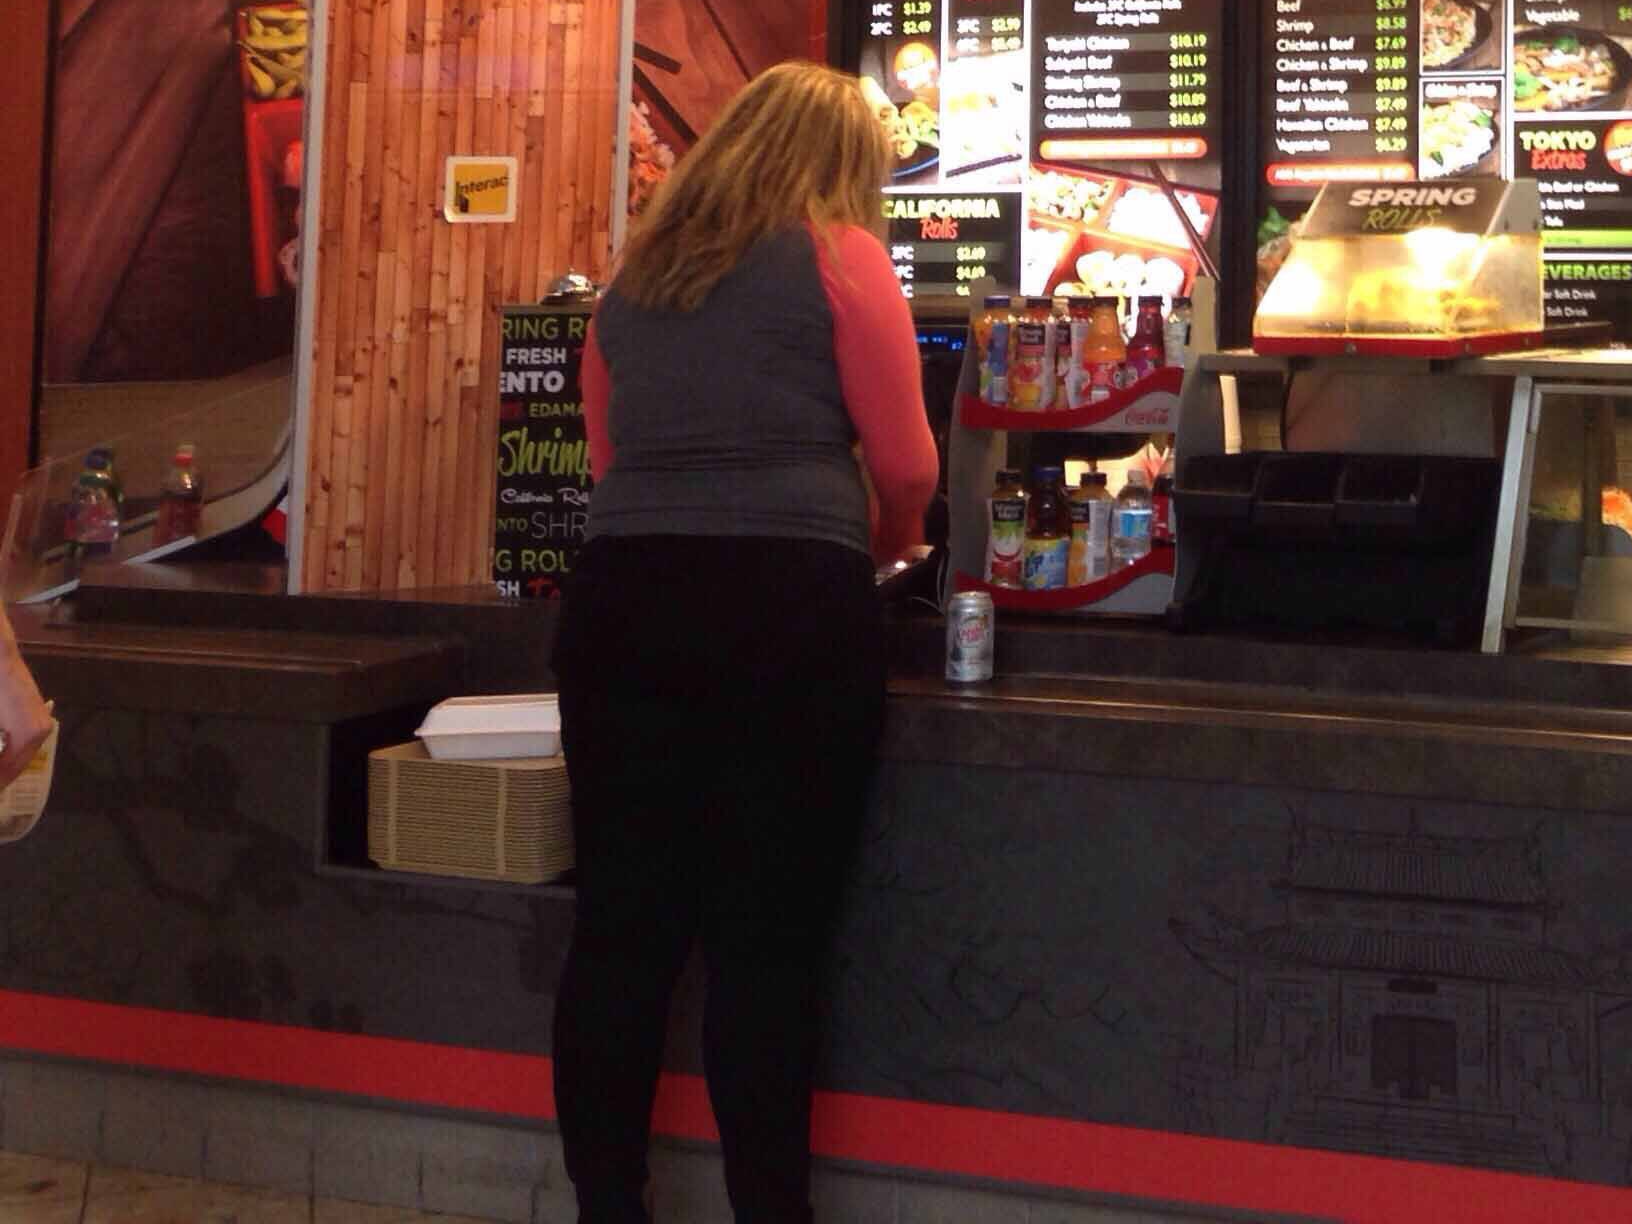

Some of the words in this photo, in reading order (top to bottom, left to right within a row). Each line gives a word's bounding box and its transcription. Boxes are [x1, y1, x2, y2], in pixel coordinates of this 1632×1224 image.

[1276, 0, 1301, 12] Beef
[1525, 8, 1580, 26] Vegetable
[1276, 19, 1314, 34] Shrimp
[1169, 34, 1207, 49] $10.19
[1276, 38, 1319, 52] Chicken
[1329, 36, 1355, 51] Beef
[1376, 36, 1407, 51] $7.69
[1169, 54, 1207, 68] $10.19
[1276, 57, 1319, 72] Chicken
[1329, 57, 1368, 73] Shrimp
[1276, 78, 1301, 92] Beef
[1309, 77, 1348, 94] Shrimp
[1519, 130, 1597, 151] TOKYO
[1531, 149, 1587, 170] Extras
[1348, 187, 1477, 207] SPRING
[881, 198, 1001, 219] CALIFORNIA
[1362, 208, 1442, 230] ROLLS
[920, 216, 958, 240] Rolls
[1572, 288, 1597, 300] Drink
[1563, 306, 1588, 317] Drink
[506, 347, 567, 365] FRESH
